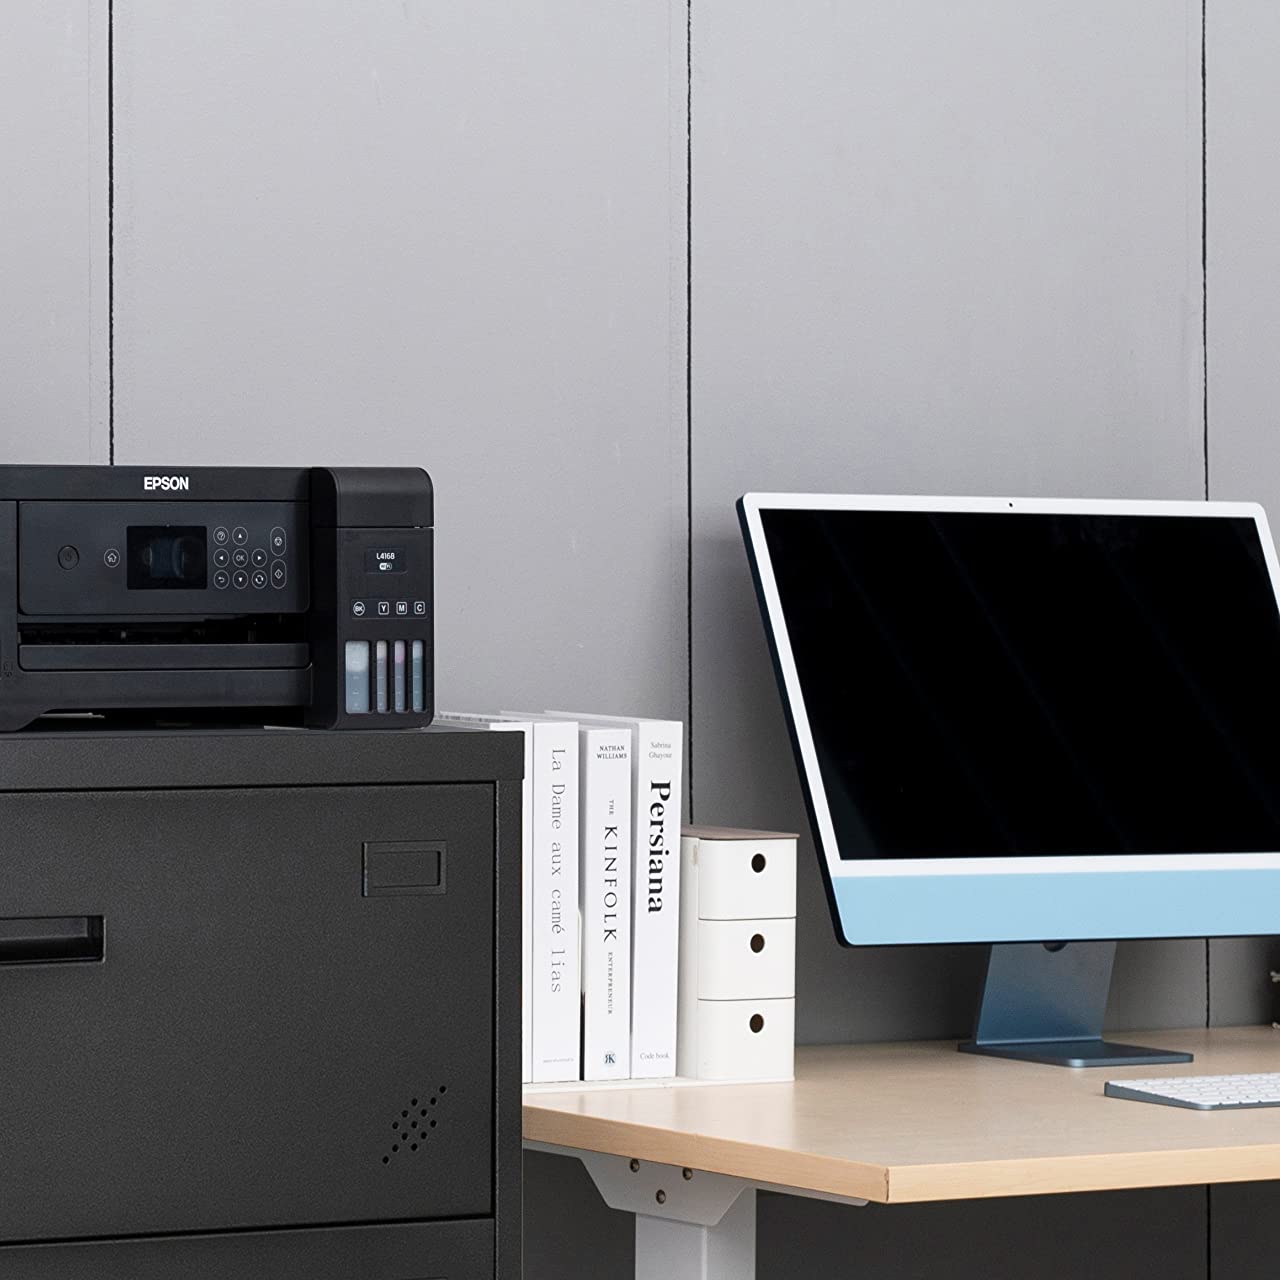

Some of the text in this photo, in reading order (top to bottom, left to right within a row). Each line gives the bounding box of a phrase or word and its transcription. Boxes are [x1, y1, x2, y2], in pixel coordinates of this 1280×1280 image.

[144, 477, 189, 490] EPSON
[552, 750, 566, 992] La Dame aux camé lias
[604, 826, 618, 942] KINFOLK
[648, 780, 671, 913] Persiana
